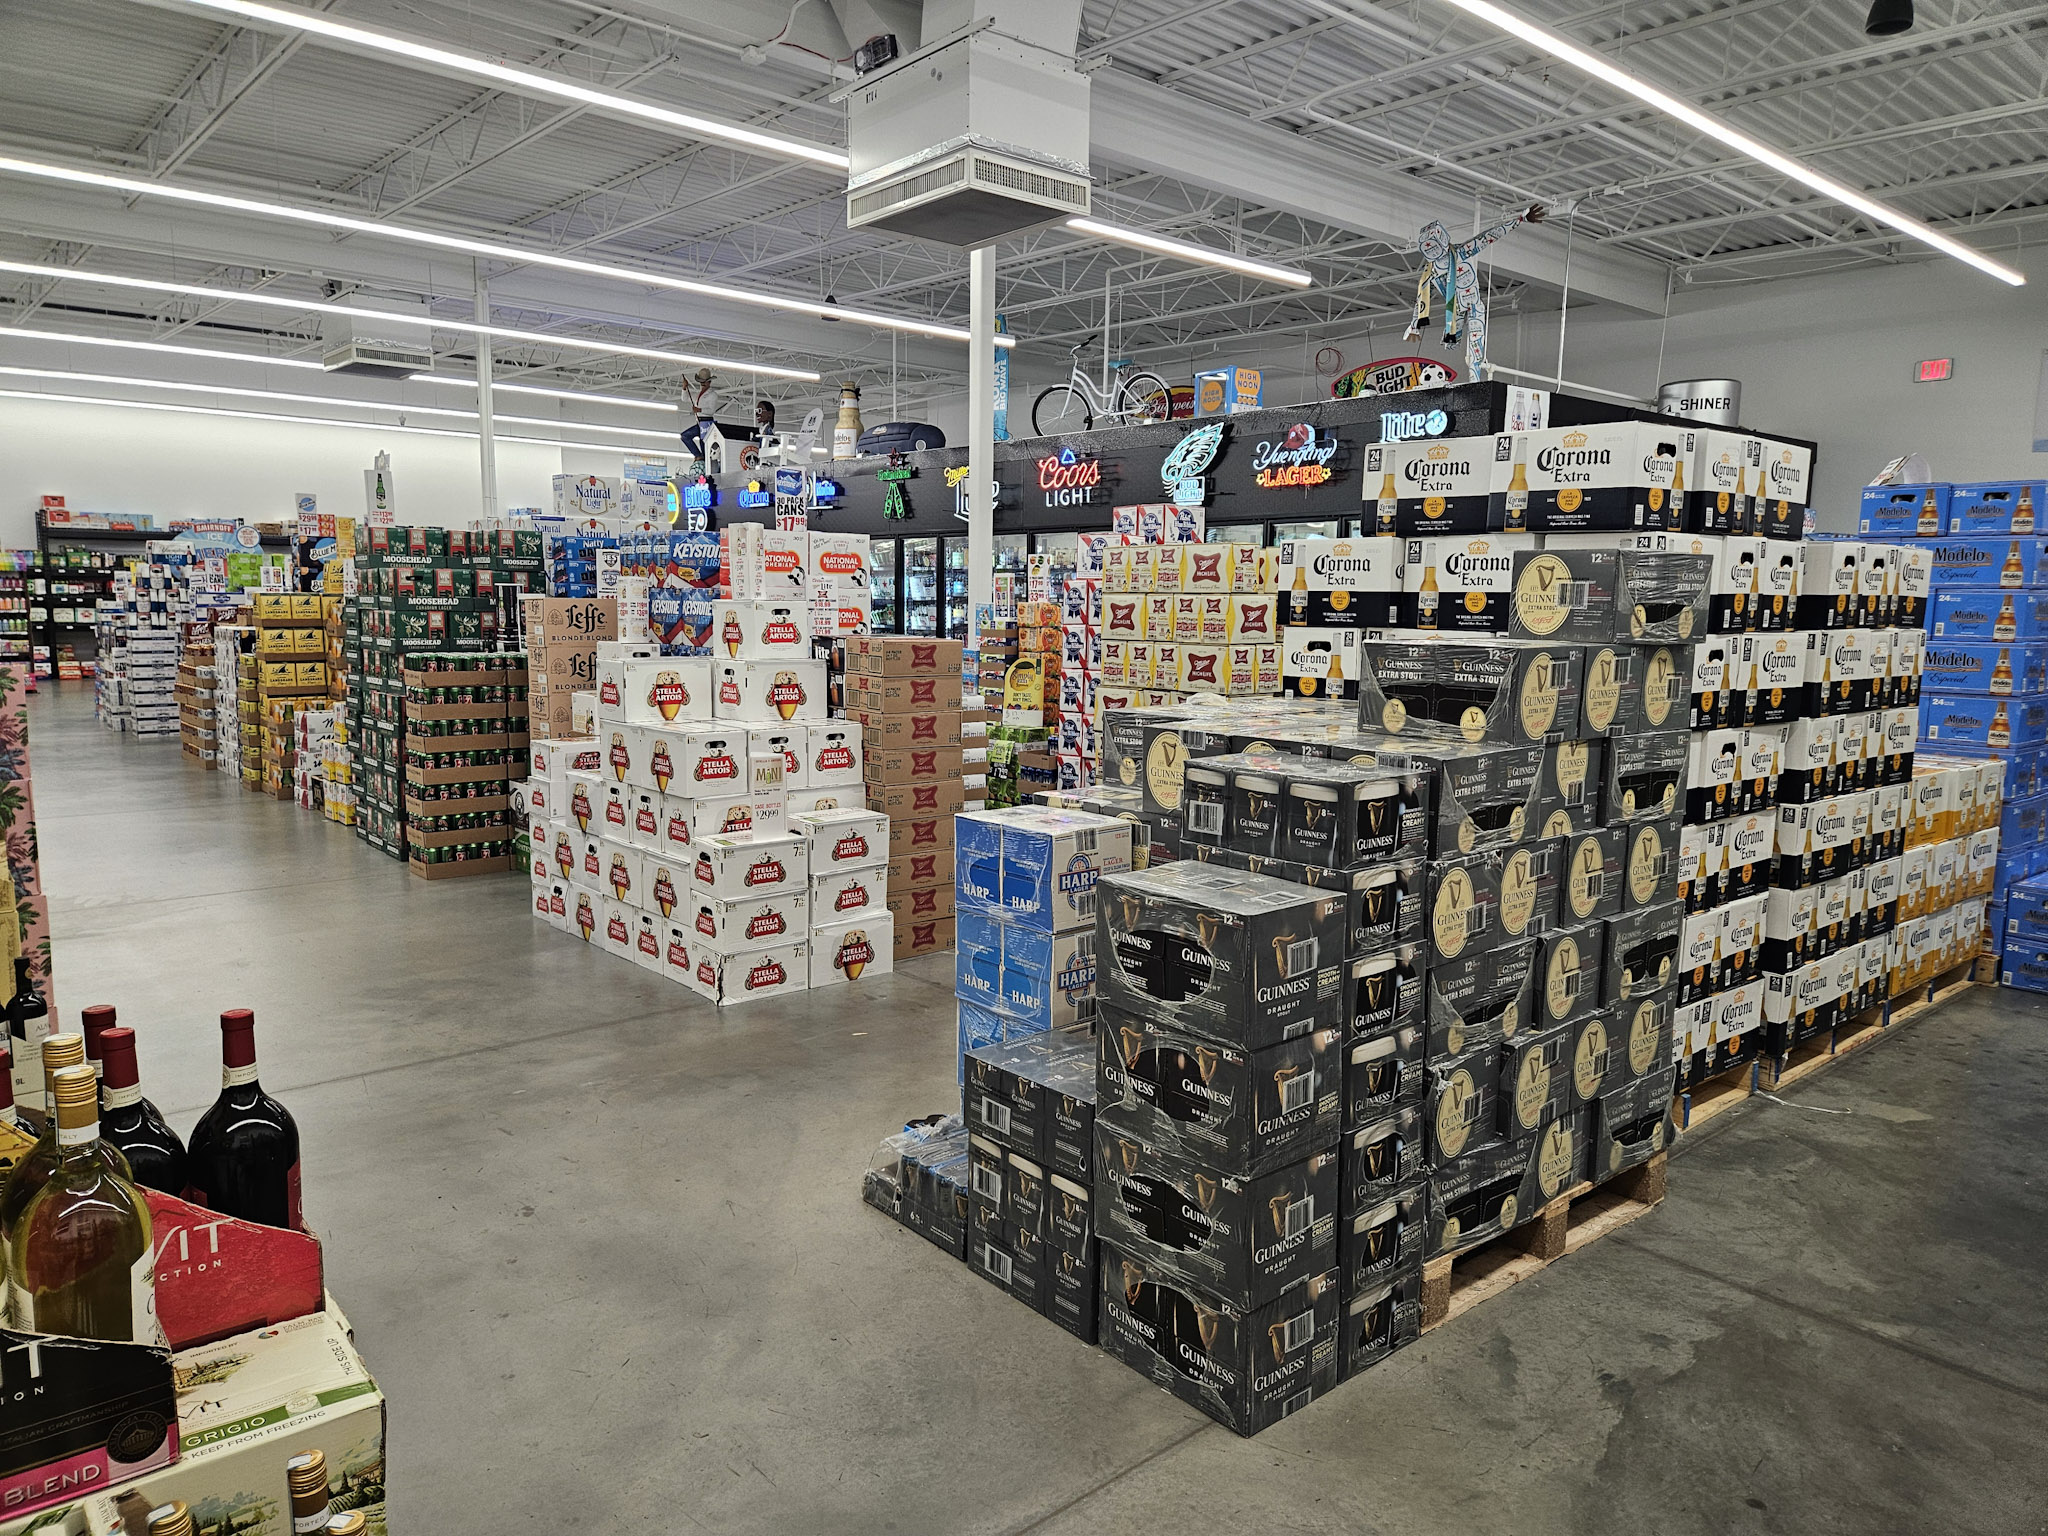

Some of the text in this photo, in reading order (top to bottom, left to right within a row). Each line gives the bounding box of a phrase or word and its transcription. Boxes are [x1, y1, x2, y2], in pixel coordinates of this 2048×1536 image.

[1239, 369, 1257, 381] HIGH
[1376, 366, 1405, 384] BUD
[1921, 360, 1949, 380] EXIT
[1237, 379, 1259, 391] NOON
[1680, 398, 1731, 411] SHINER
[1380, 412, 1426, 443] Lite
[1499, 438, 1509, 450] 24
[1253, 439, 1338, 470] Yuengling
[1370, 451, 1380, 461] 24
[1537, 447, 1611, 472] Corona
[1644, 456, 1673, 472] Corona
[1712, 460, 1737, 478] Corona
[1040, 456, 1101, 489] Coors
[1264, 465, 1324, 487] LAGER
[1405, 459, 1471, 483] Corona
[1551, 468, 1590, 483] Extra
[1771, 460, 1800, 483] Corona
[576, 484, 611, 499] Natural
[1180, 480, 1198, 490] BUD
[1417, 479, 1453, 492] Extra
[639, 487, 663, 497] Natural
[685, 486, 711, 508] Blue
[1046, 486, 1092, 507] LIGHT
[1176, 488, 1202, 499] LIGHT
[586, 499, 602, 509] Light
[777, 505, 804, 516] CANS
[196, 524, 232, 533] SMIRNOFF
[534, 523, 561, 533] Natural
[207, 533, 223, 541] ICE
[583, 539, 604, 548] Natty
[1639, 537, 1648, 547] 24
[1283, 544, 1292, 554] 24
[1410, 543, 1420, 554] 24
[1934, 547, 1985, 562] Modelo
[382, 556, 432, 564] MOOSEHEAD
[765, 556, 796, 564] ATIONAL
[823, 557, 859, 565] NATIONAL
[1314, 554, 1371, 575] Corona
[1446, 550, 1510, 575] Corona
[1591, 553, 1601, 563] 12
[1196, 560, 1214, 570] Miller
[1326, 573, 1355, 586] Extra
[1939, 569, 1977, 579] Especial
[408, 598, 459, 606] MOOSEHEAD
[1520, 592, 1558, 604] GUINNE
[652, 600, 680, 615] KEYSTONE
[682, 600, 712, 616] KEYSTONE
[565, 603, 607, 634] Leffe
[1955, 610, 1985, 620] Modelo
[815, 645, 830, 660] lite
[1291, 651, 1327, 665] Corona
[1408, 647, 1418, 656] 12
[1385, 660, 1423, 670] GUINNESS
[1763, 651, 1796, 673] Corona
[1925, 651, 1975, 668] Modelo
[1462, 662, 1504, 673] GUINNESS
[1378, 670, 1422, 680] EXTRA STOUT
[1454, 673, 1504, 685] EXTRA STOUT
[655, 688, 684, 696] STELLA
[655, 694, 683, 702] ARTOIS
[774, 687, 800, 696] STELLA
[774, 694, 800, 702] ARTOIS
[1589, 689, 1617, 700] GUINNESS
[1524, 696, 1555, 706] GUINNESS
[823, 751, 849, 759] STELLA
[703, 760, 730, 768] STELLA
[1559, 759, 1587, 769] GUINNESS
[703, 767, 730, 775] ARTOIS
[1412, 777, 1418, 789] 8
[1461, 772, 1487, 784] GUINNESS
[1455, 784, 1487, 797] EXTRA STOUT
[1402, 817, 1425, 826] CREAMY
[1403, 812, 1422, 820] SMOOTH
[1240, 818, 1270, 830] GUINNESS
[1295, 828, 1327, 840] GUINNESS
[839, 841, 862, 849] STELLA
[1357, 835, 1393, 849] GUINNESS
[1734, 830, 1764, 853] Corona
[839, 847, 863, 855] ARTOIS
[753, 865, 778, 875] STELLA
[753, 871, 778, 881] ARTOIS
[1061, 871, 1098, 891] HARP
[963, 883, 990, 899] HARP
[1069, 885, 1089, 893] LAGER
[1012, 896, 1040, 913] HARP
[1324, 902, 1335, 915] 12
[1110, 928, 1152, 950] GUINNESS
[1182, 947, 1232, 972] GUINNESS
[754, 967, 779, 977] STELLA
[1060, 967, 1095, 984] HARP
[1317, 970, 1335, 980] SMOOTH
[753, 974, 779, 984] ARTOIS
[964, 974, 991, 991] HARP
[1317, 974, 1341, 987] CREAMY
[1257, 977, 1311, 1003] GUINNESS
[1012, 990, 1040, 1008] HARP
[1267, 1000, 1300, 1015] DRAUGHT
[1721, 1000, 1753, 1025] Corona
[1355, 1007, 1391, 1027] GUINNESS
[1182, 1079, 1232, 1107] GUINNESS
[1108, 1169, 1153, 1196] GUINNESS
[1181, 1205, 1231, 1236] GUINNESS
[1312, 1222, 1334, 1238] CREAMY
[1254, 1231, 1306, 1265] GUINNESS
[159, 1258, 223, 1283] CTION
[1264, 1254, 1296, 1274] DRAUGHT
[1108, 1303, 1156, 1339] GUINNESS
[189, 1341, 239, 1358] IMPORTED BY
[326, 1337, 355, 1376] THIS SIDE UP
[1180, 1343, 1235, 1385] GUINNESS
[1189, 1367, 1224, 1392] DRAUGHT
[1254, 1355, 1306, 1392] GUINNESS
[1264, 1379, 1296, 1401] DRAUGHT
[185, 1415, 267, 1448] GRIGIO
[191, 1410, 327, 1459] KEEP FROM FREEZING
[4, 1464, 100, 1507] BLEND
